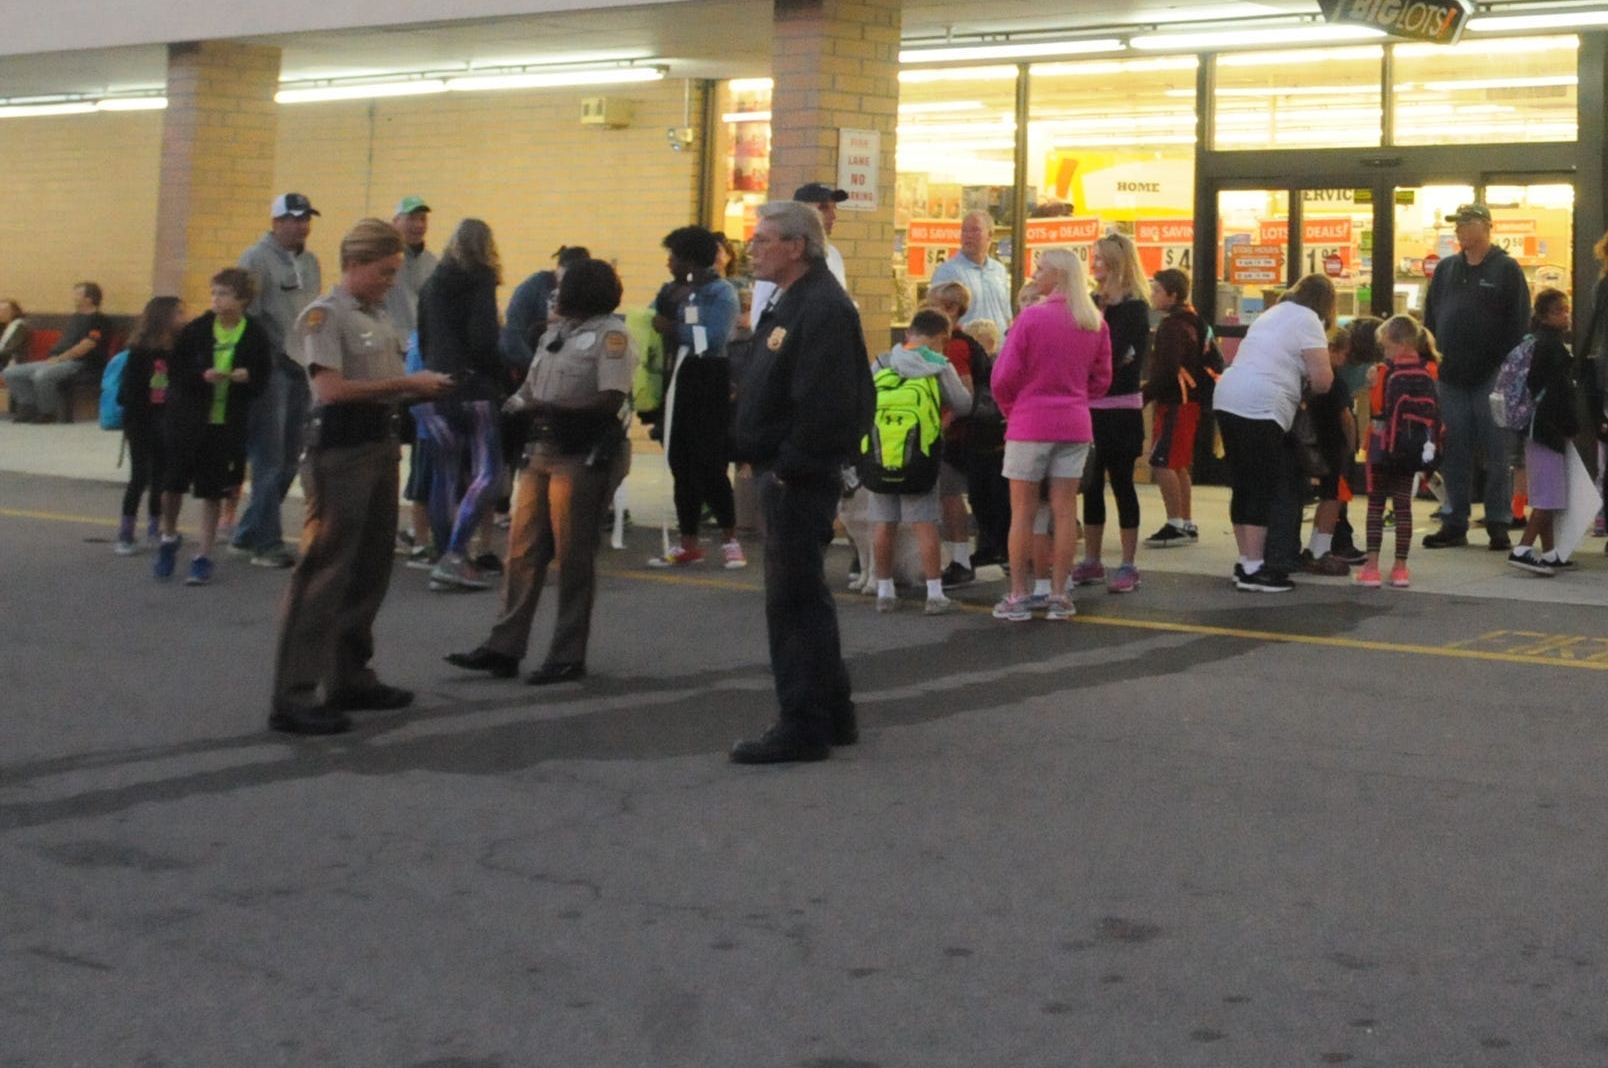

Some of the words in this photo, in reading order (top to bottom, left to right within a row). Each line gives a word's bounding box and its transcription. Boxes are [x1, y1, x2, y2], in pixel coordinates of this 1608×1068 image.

[850, 173, 867, 187] NO
[1116, 181, 1161, 193] HOME
[1026, 229, 1047, 240] OTS
[1139, 226, 1160, 239] BIG
[1305, 222, 1350, 239] DEALS!
